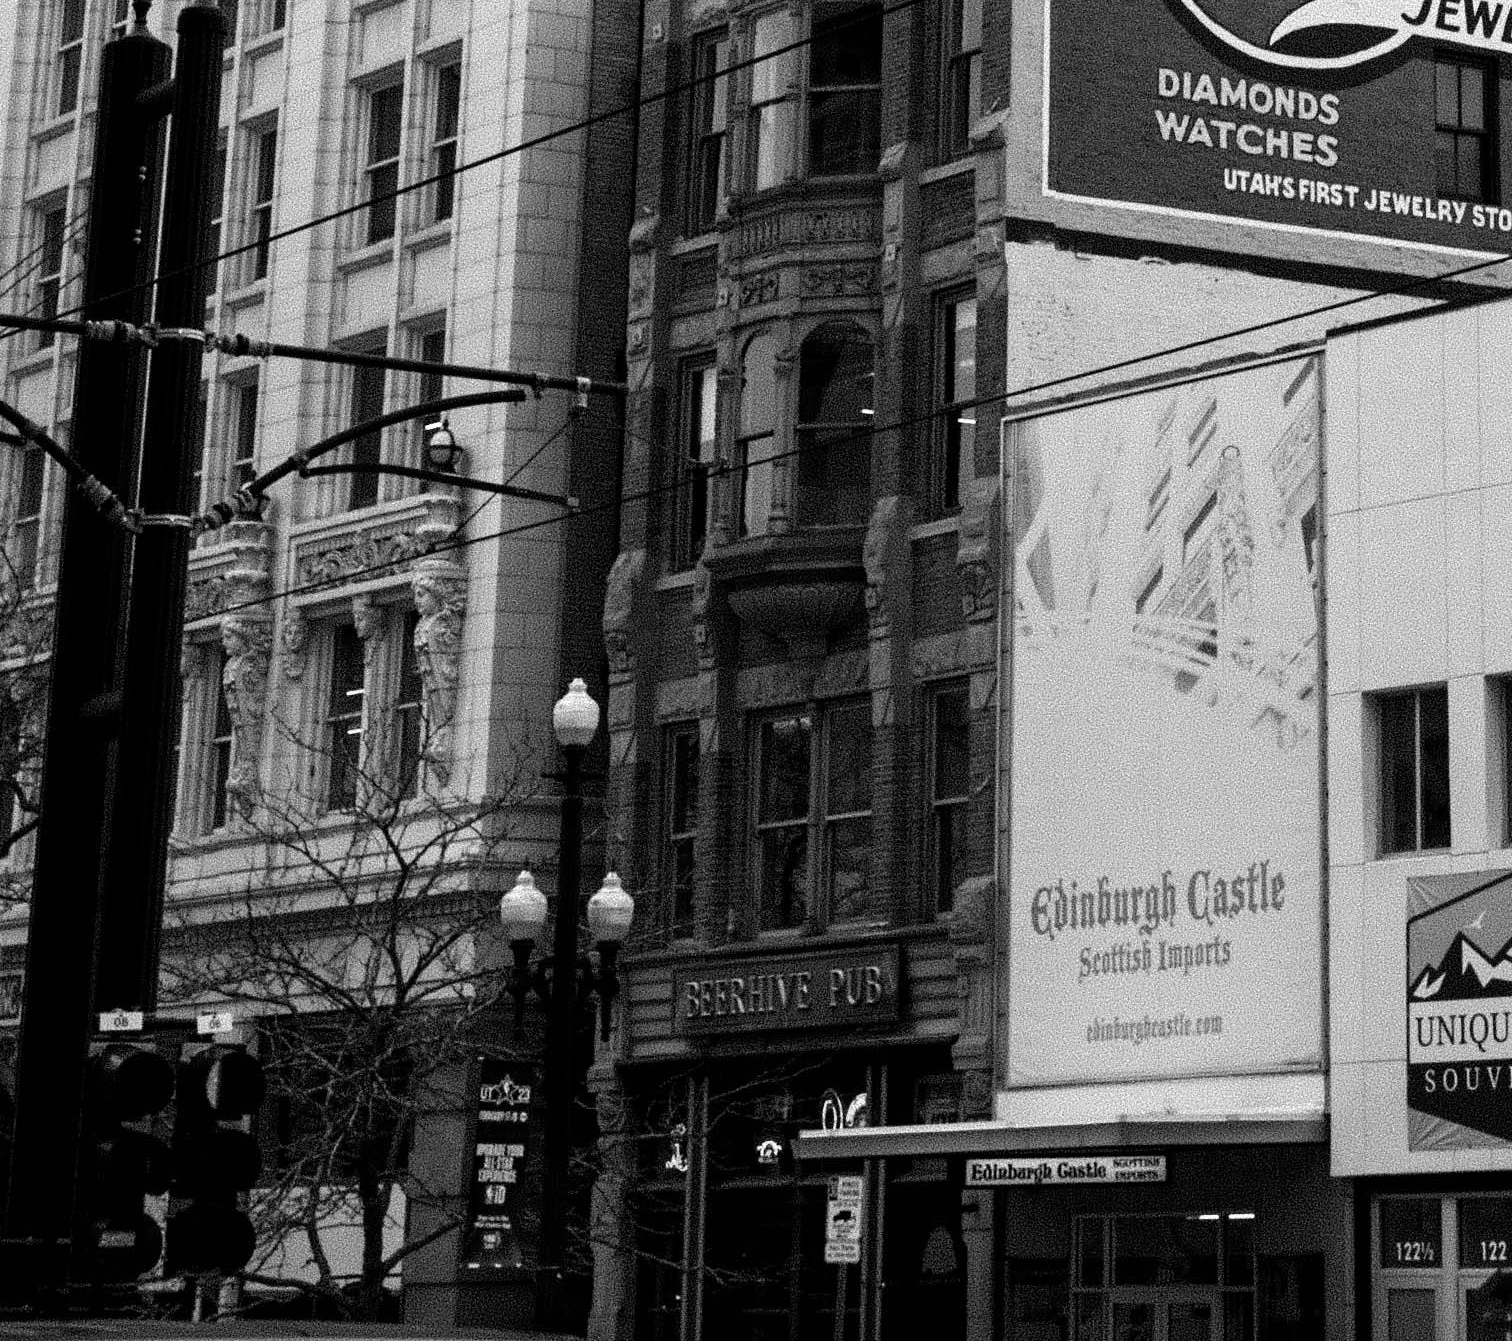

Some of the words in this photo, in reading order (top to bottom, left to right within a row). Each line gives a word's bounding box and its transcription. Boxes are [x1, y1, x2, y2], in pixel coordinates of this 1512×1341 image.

[1157, 68, 1340, 125] DIAMONDS
[1154, 109, 1339, 167] WATCHES
[1224, 168, 1296, 200] UTAH'S
[1298, 179, 1359, 208] FIRST
[1364, 189, 1467, 225] JEWELRY
[1030, 869, 1178, 941] Edinburgh
[1187, 859, 1287, 927] Castle
[1077, 938, 1152, 984] Scottish
[1156, 934, 1232, 977] Imports
[686, 970, 813, 1017] BEERHIVE
[829, 965, 883, 1008] PUB
[1480, 1240, 1508, 1262] 122
